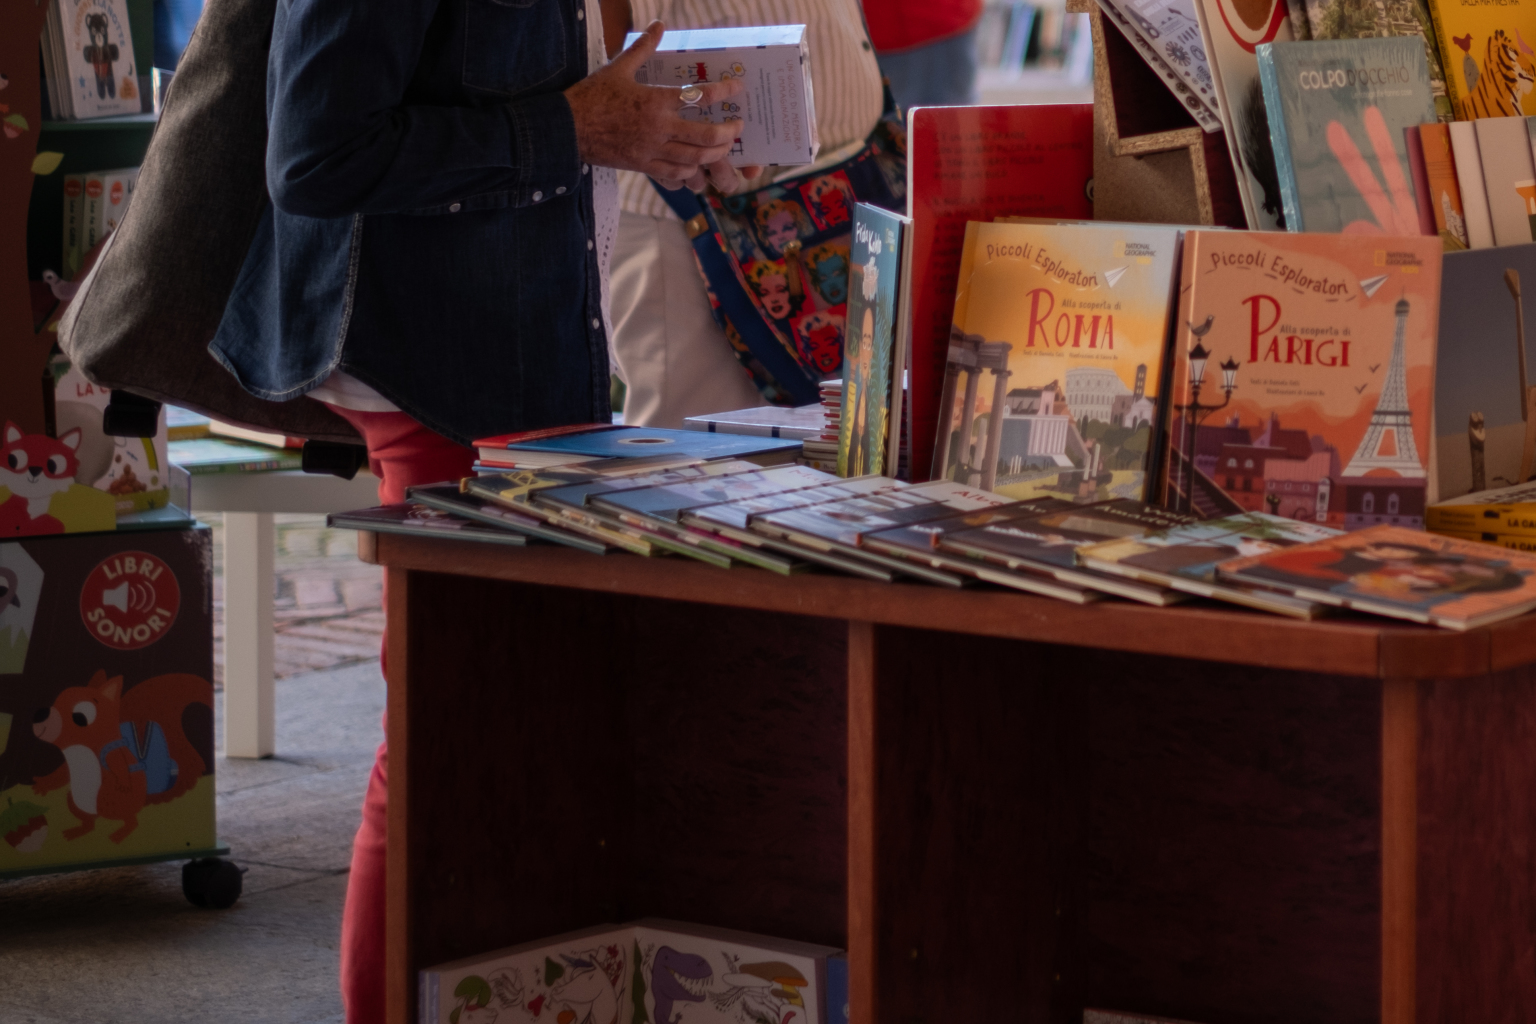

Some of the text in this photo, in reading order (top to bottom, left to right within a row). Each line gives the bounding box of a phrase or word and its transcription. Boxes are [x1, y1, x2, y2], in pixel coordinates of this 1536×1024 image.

[1299, 64, 1410, 90] COLPO D'OCCHIO
[855, 221, 869, 244] Frida
[1124, 249, 1156, 257] GEOGRAPHIC
[1125, 242, 1150, 250] NATIONAL
[1386, 251, 1416, 259] NATIONAL
[986, 242, 1098, 288] Piccoli Esploratori
[1385, 258, 1424, 267] GEOGRAPHIC
[1210, 249, 1349, 296] Piccoli Esploratori
[1061, 298, 1122, 311] Alla scoperta di
[1025, 287, 1114, 350] ROMA
[1241, 294, 1352, 368] PARIGI
[1279, 324, 1351, 337] Alla scoperta di
[76, 382, 95, 398] LA
[1507, 518, 1519, 528] LA
[101, 556, 164, 582] LIBRI
[87, 607, 172, 645] SONORI
